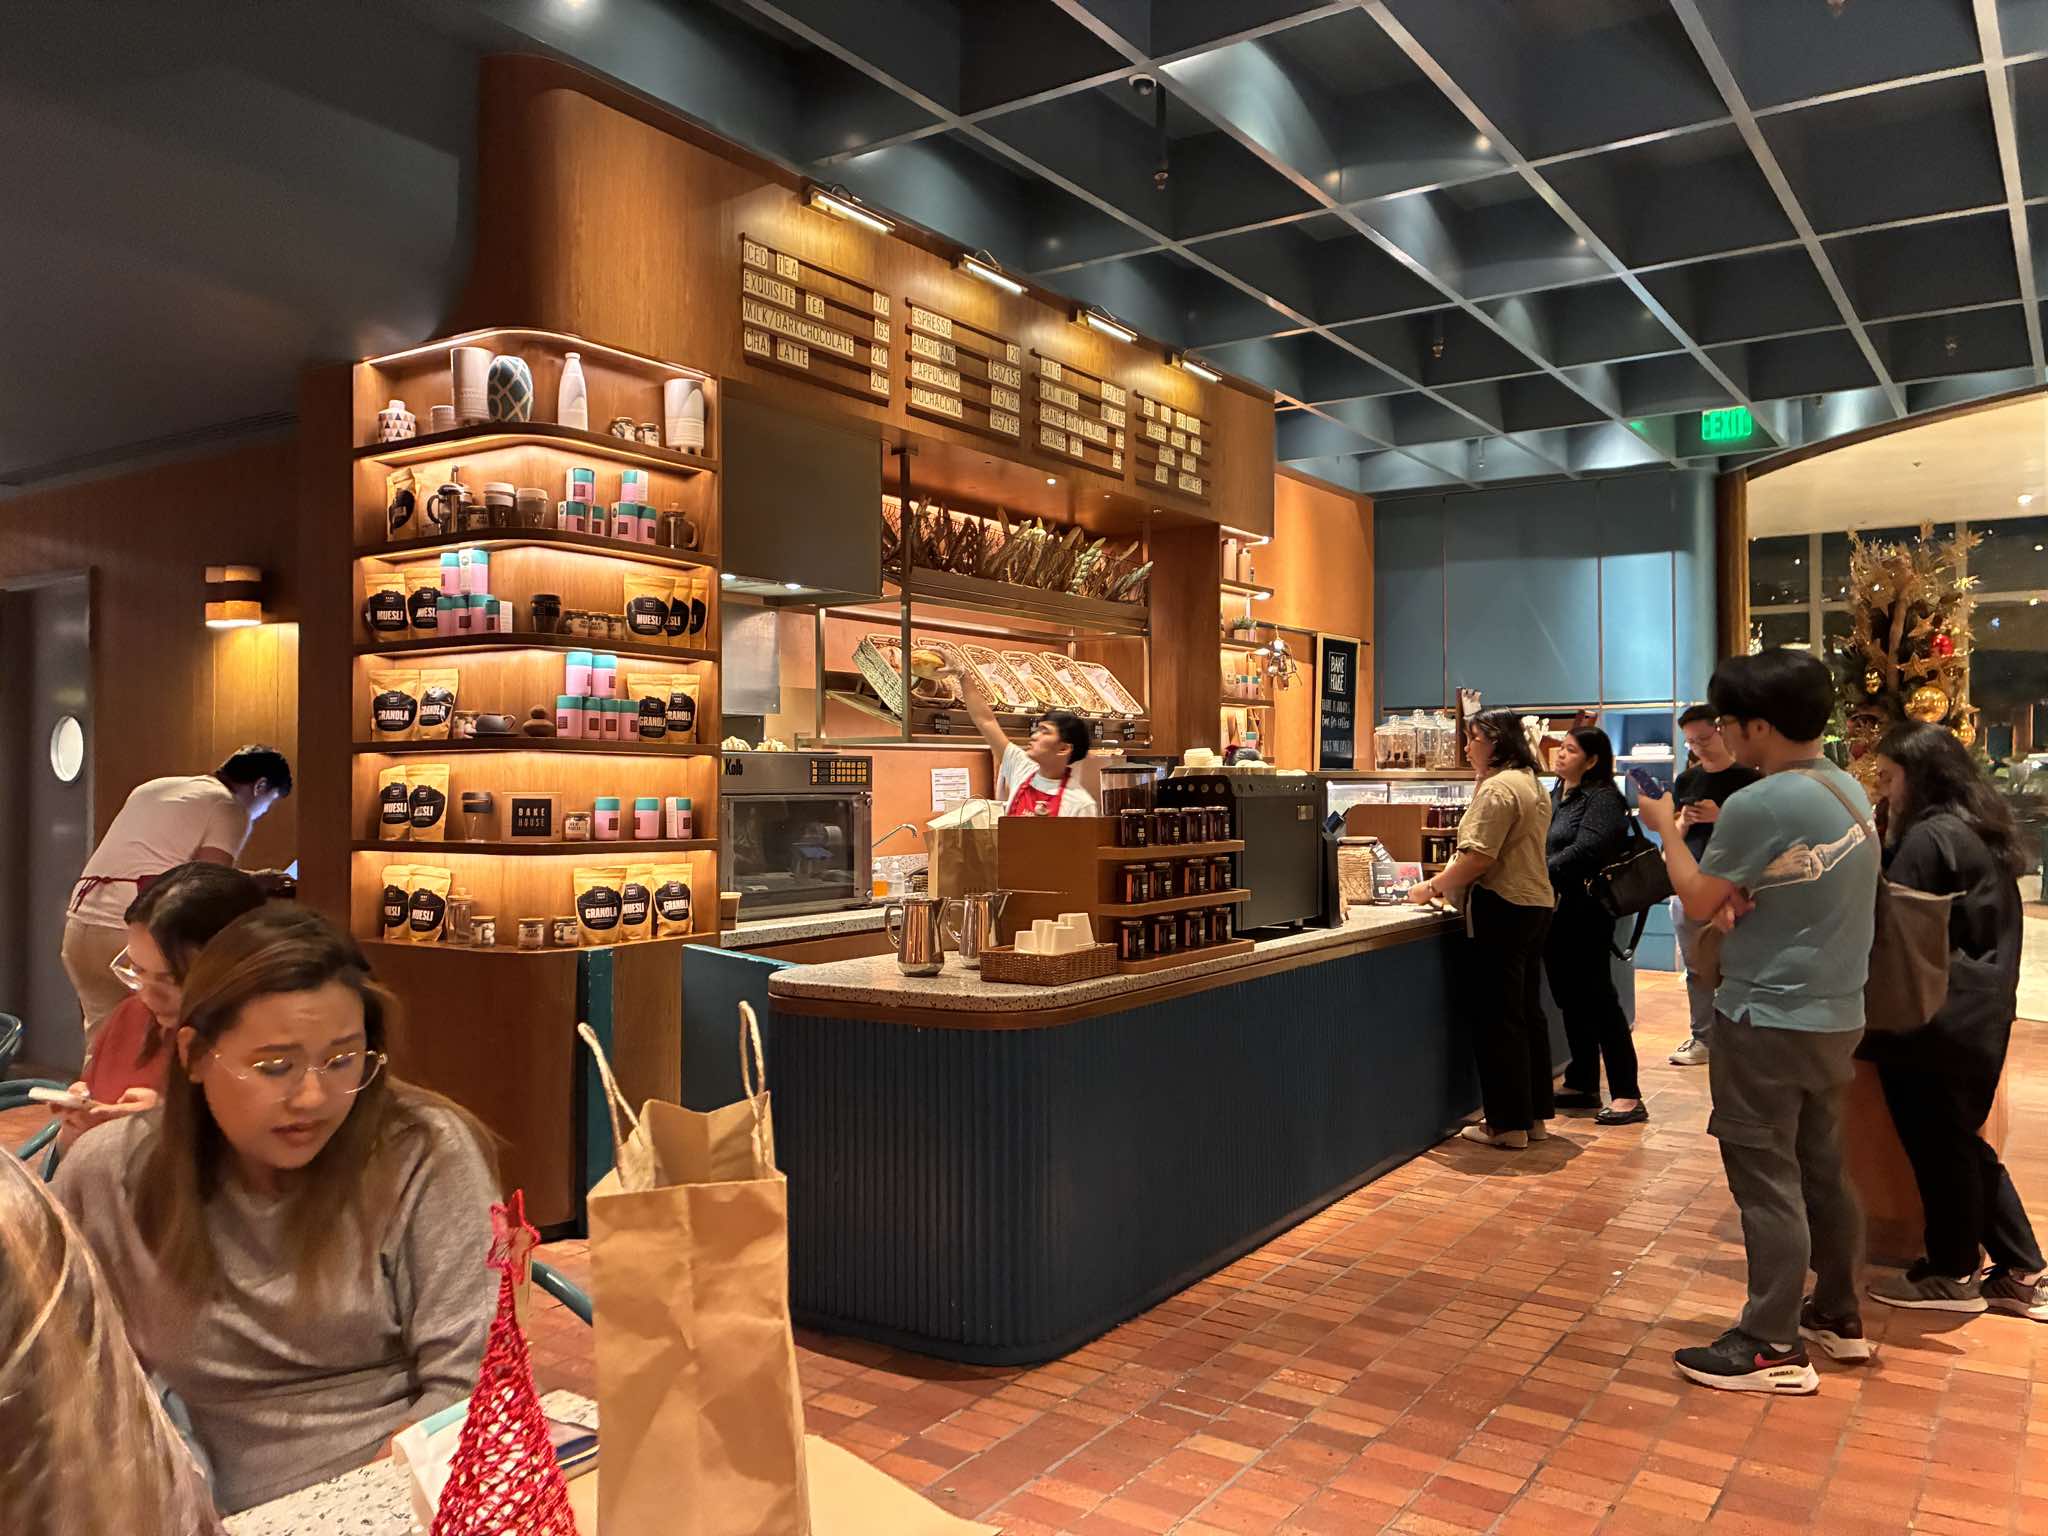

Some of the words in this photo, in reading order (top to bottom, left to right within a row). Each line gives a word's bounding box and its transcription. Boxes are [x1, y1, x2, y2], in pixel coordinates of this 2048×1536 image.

[744, 243, 768, 267] ICED
[778, 255, 798, 279] TEA
[874, 293, 890, 314] 170
[743, 272, 796, 308] EXQUISITE
[807, 295, 825, 318] TEA
[875, 320, 890, 341] 165
[912, 309, 952, 337] ESPRESSO
[745, 331, 770, 355] CHAI
[777, 343, 808, 367] LATTE
[872, 346, 888, 366] 210
[912, 336, 956, 364] AMERICANO
[912, 361, 960, 390] CAPPUCCINO
[1710, 409, 1746, 439] EXIT
[376, 610, 404, 621] MUESLI
[636, 614, 662, 625] MUESLI
[1330, 655, 1344, 674] BAKE
[377, 709, 409, 721] GRANOLA
[725, 758, 744, 776] Kolb
[383, 802, 408, 814] MUESLI
[518, 807, 545, 817] BAKE
[518, 818, 545, 828] HOUSE
[411, 908, 434, 922] MUESLI
[585, 906, 618, 919] GRANOLA
[622, 902, 645, 915] MUESLI
